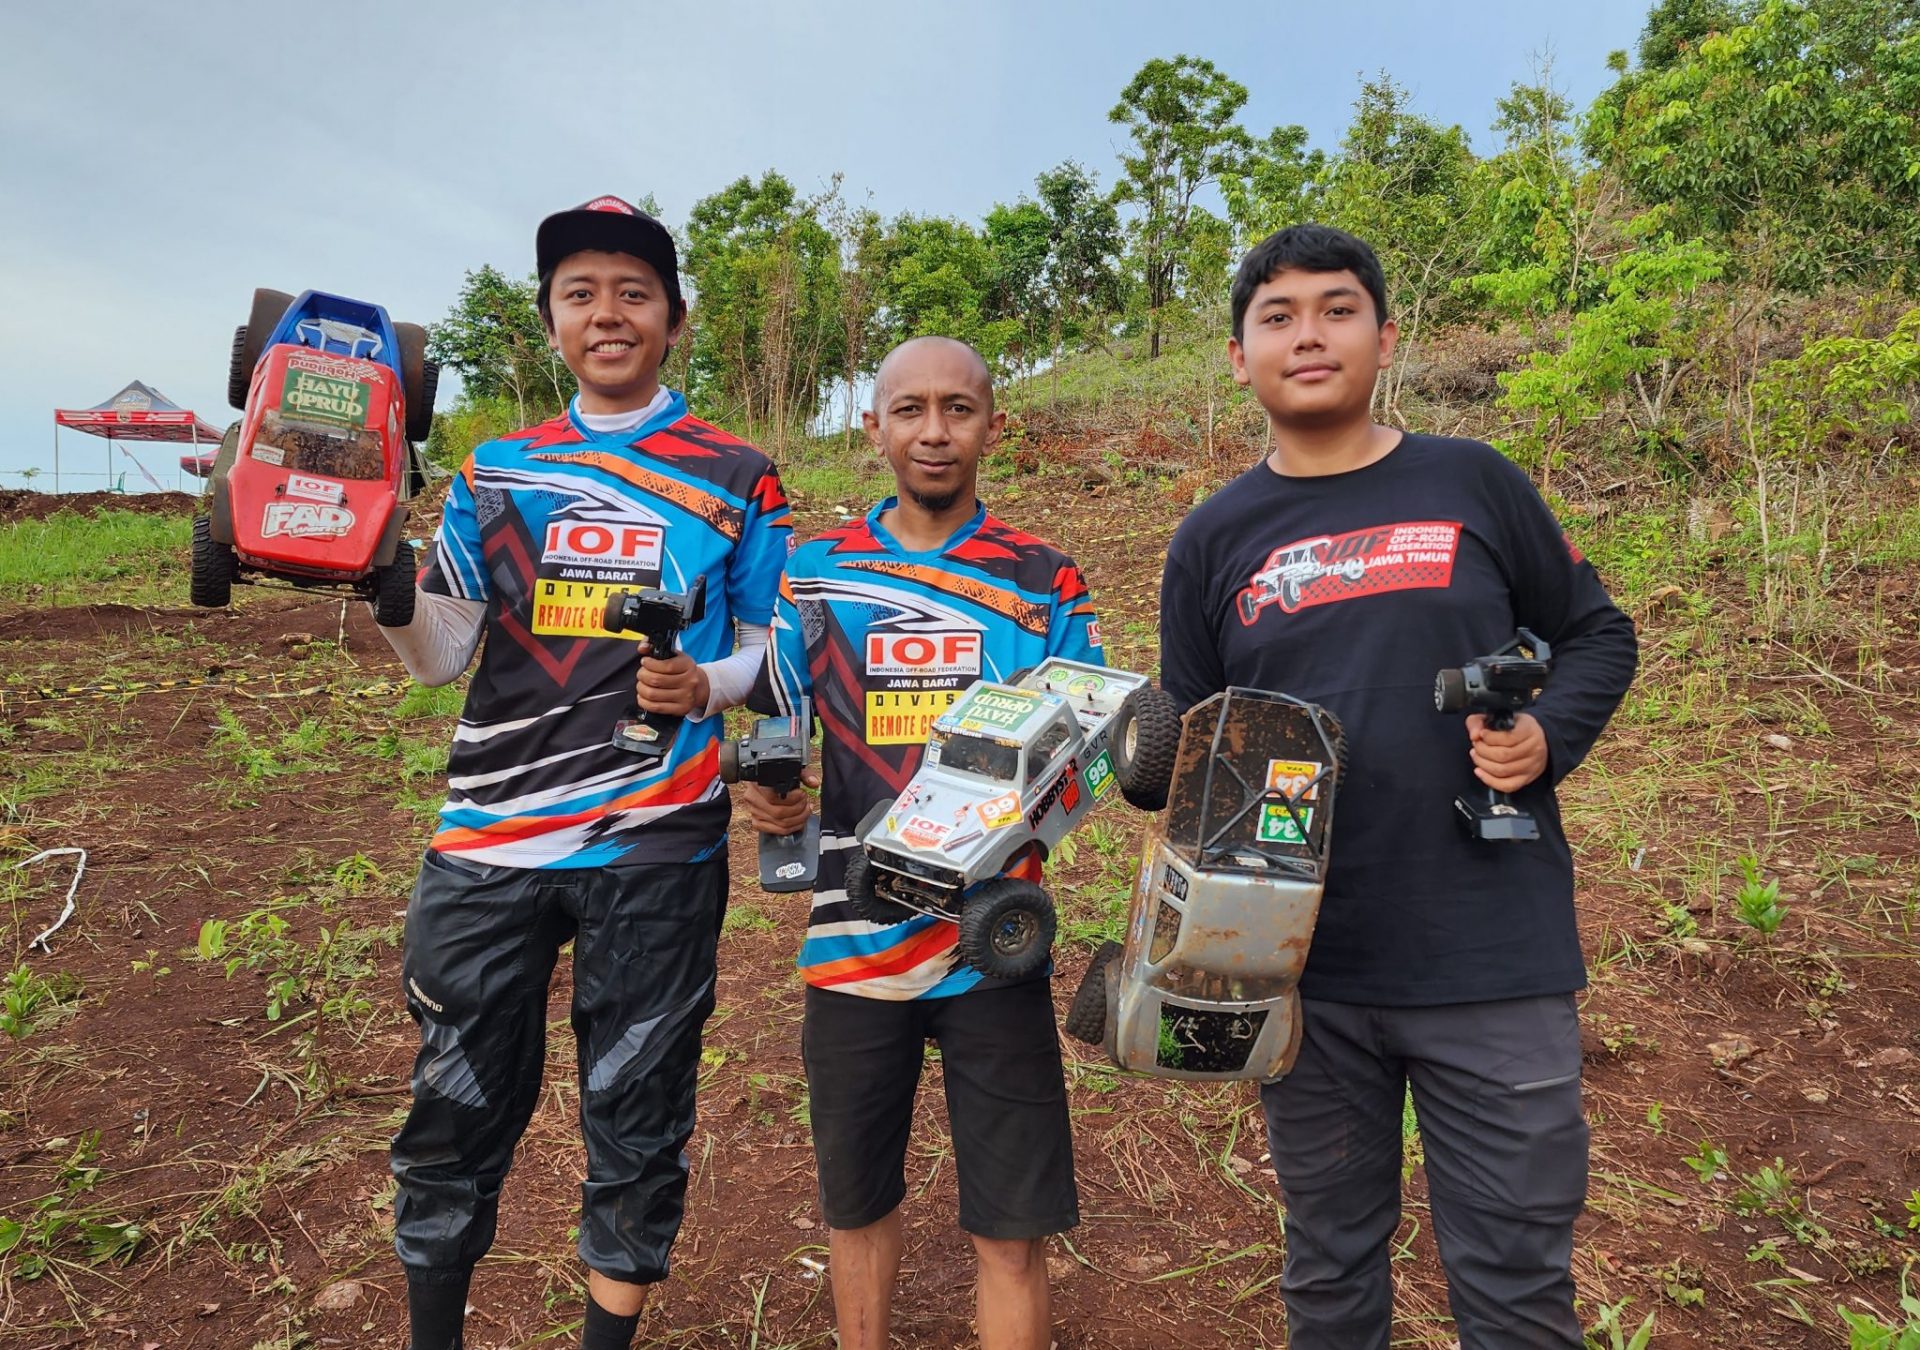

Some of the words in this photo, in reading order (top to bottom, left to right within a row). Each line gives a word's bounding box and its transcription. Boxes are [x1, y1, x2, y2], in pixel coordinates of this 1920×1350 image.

[294, 377, 360, 400] HAYU
[287, 391, 364, 416] OPRUD
[295, 479, 338, 492] IOF
[264, 504, 354, 536] FAD
[1394, 525, 1456, 535] INDONESIA
[547, 525, 658, 557] IOF
[1386, 542, 1453, 552] FEDERATION
[1389, 534, 1455, 544] OFF-ROAD
[544, 554, 578, 563] INDONESIA
[580, 557, 613, 565] OFF-ROAD
[614, 559, 656, 568] FEDERATION
[1365, 553, 1404, 568] JAWA
[1407, 552, 1450, 563] TIMUR
[559, 568, 593, 579] JAWA
[596, 570, 636, 581] BARAT
[538, 604, 586, 628] REMOTE
[870, 636, 977, 665] IOF
[886, 678, 919, 688] JAWA
[922, 678, 959, 688] BARAT
[875, 693, 955, 707] DIVIS
[871, 715, 916, 737] REMOTE
[1088, 758, 1108, 786] 99
[983, 797, 1015, 819] 99
[909, 817, 951, 835] IOF
[1268, 817, 1299, 839] 34
